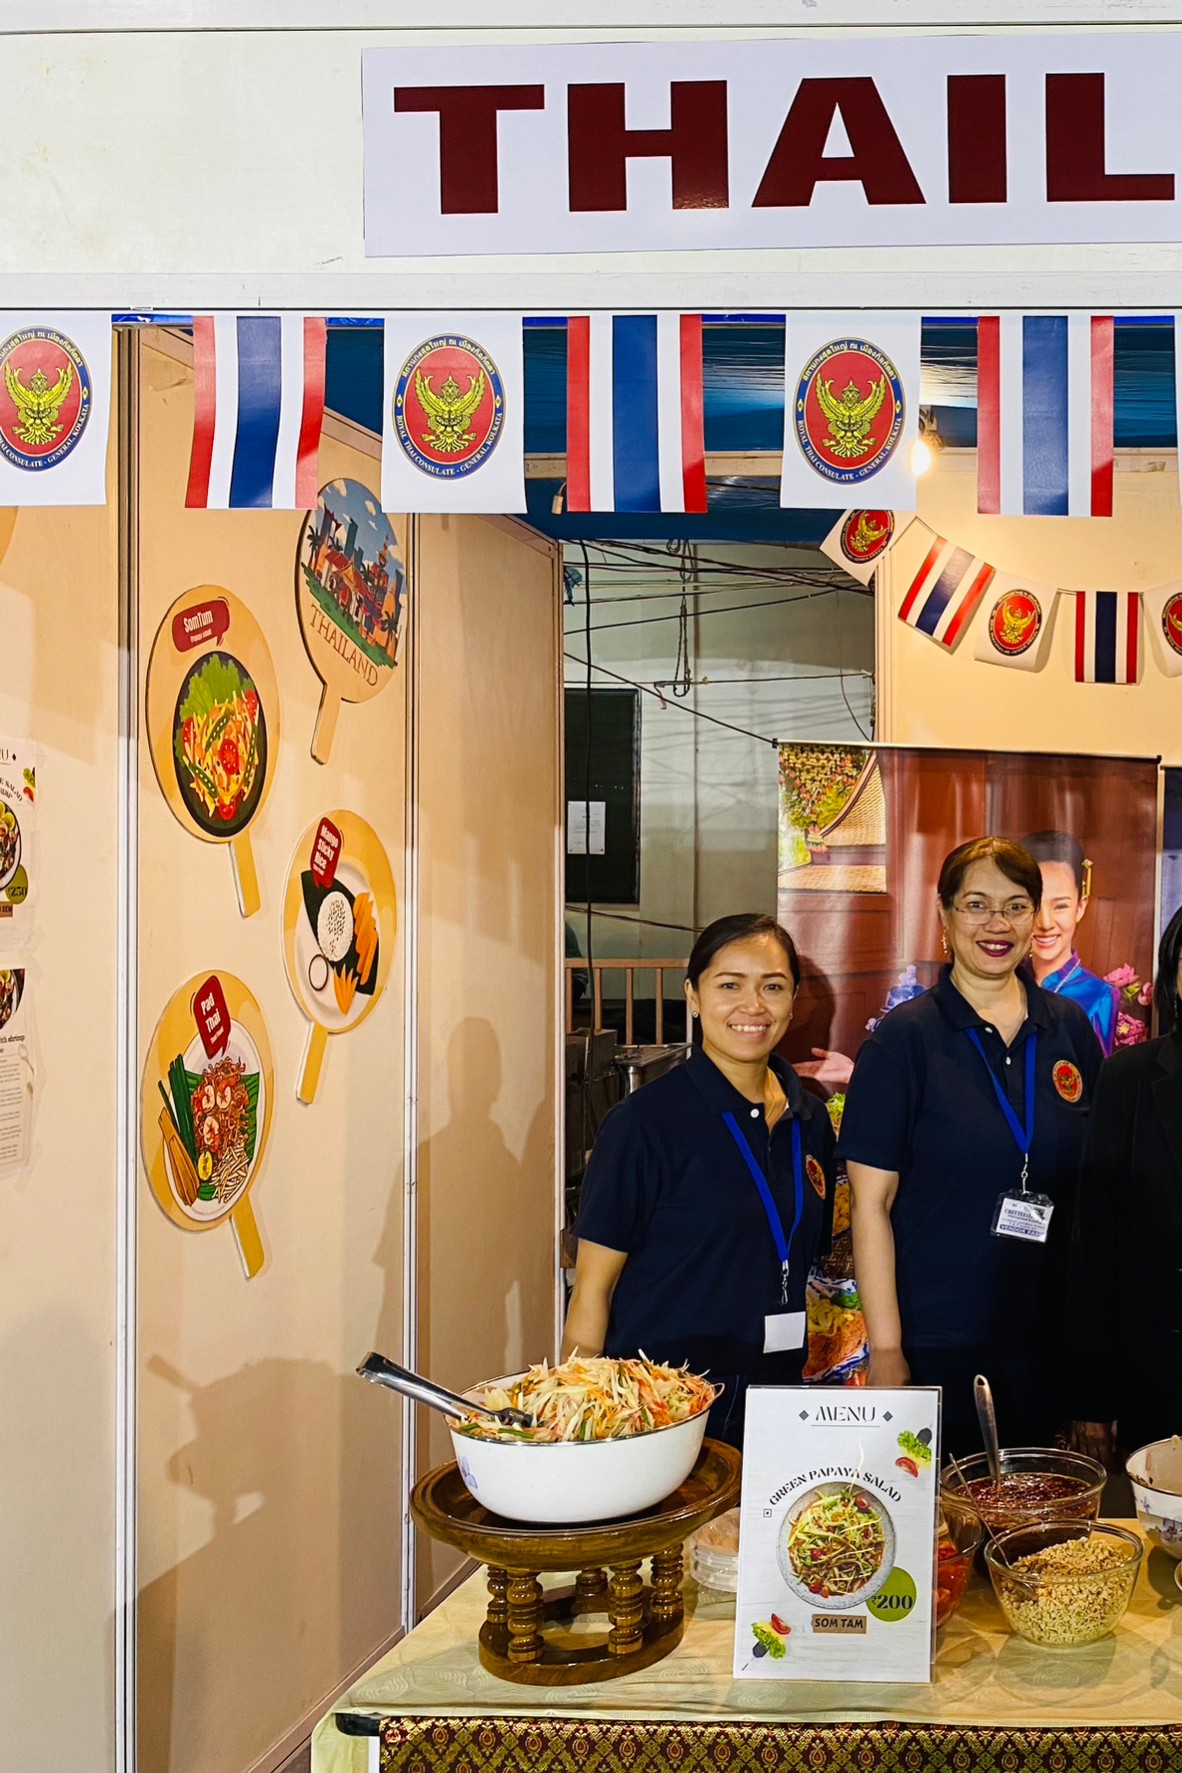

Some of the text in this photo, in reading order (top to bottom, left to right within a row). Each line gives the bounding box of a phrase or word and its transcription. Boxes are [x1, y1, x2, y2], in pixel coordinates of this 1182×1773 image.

[6, 449, 43, 468] CONSULATE
[73, 404, 89, 437] KOLKATA
[396, 415, 408, 440] ROYAL
[404, 440, 417, 459] THAI
[414, 456, 455, 476] CONSULATE
[487, 412, 502, 447] KOLKATA
[798, 420, 808, 444] ROYAL
[805, 445, 817, 464] THAI
[815, 462, 854, 480] CONSULATE
[886, 418, 902, 452] KOLKATA
[184, 610, 214, 633] SomTum
[310, 604, 378, 686] THAILAND
[201, 992, 215, 1016] Pad
[205, 1008, 220, 1033] Thai
[816, 1406, 876, 1422] MENU
[769, 1466, 902, 1506] GREEN PAPAYA SALAD
[814, 1618, 864, 1629] SOM TAM
